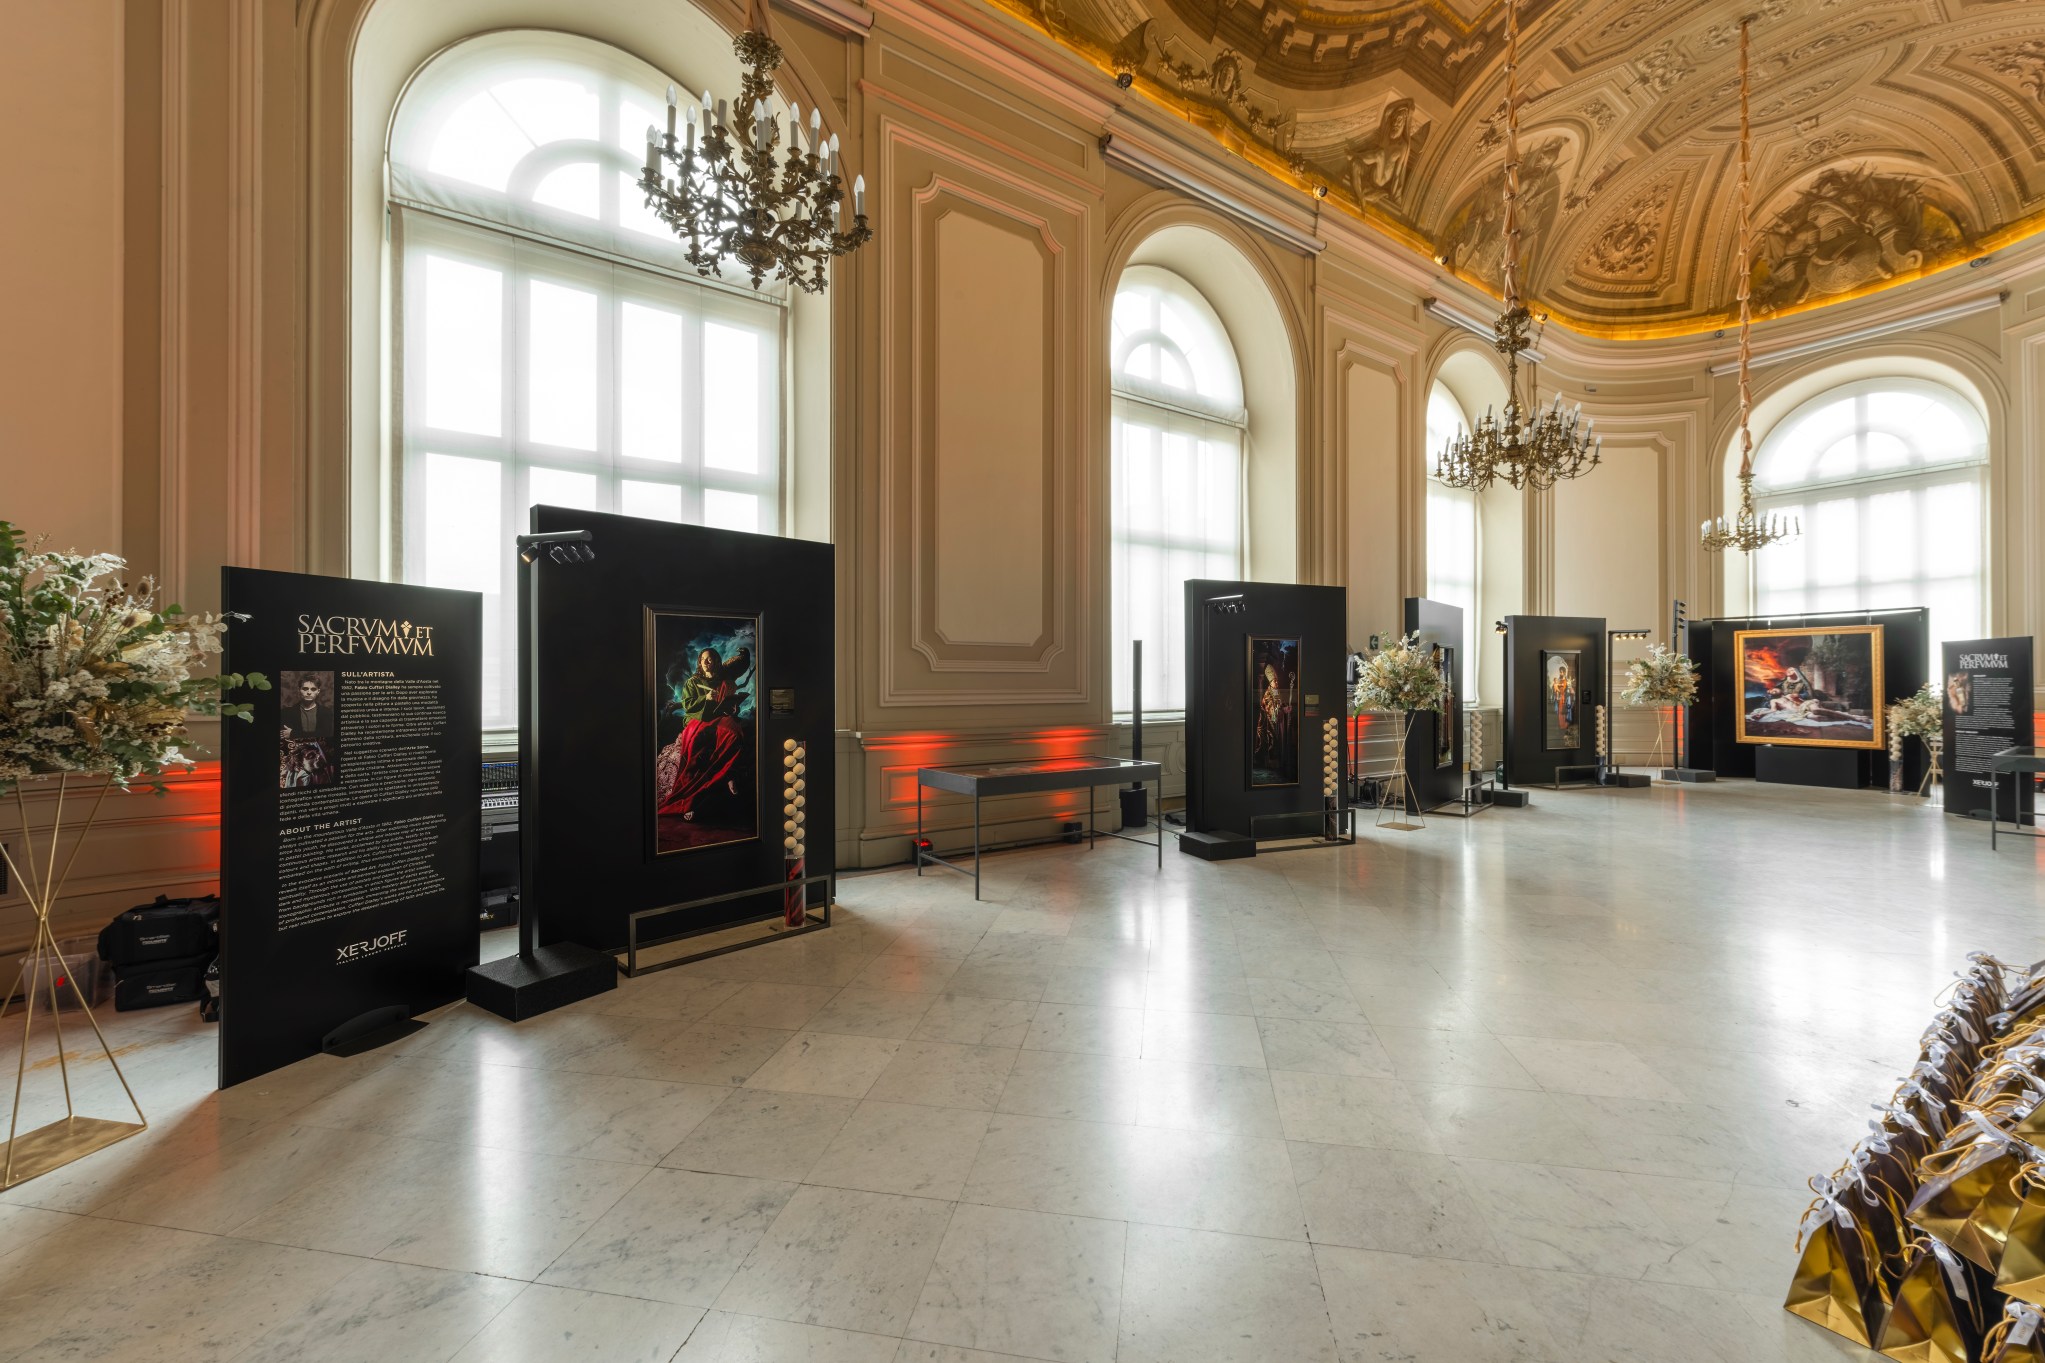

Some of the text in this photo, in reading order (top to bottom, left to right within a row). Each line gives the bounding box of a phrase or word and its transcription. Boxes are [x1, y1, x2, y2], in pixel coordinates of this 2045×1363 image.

[297, 614, 433, 639] SACRVM ET
[298, 633, 434, 656] PERFVMVM
[1972, 779, 2000, 787] XERJOF
[279, 817, 363, 836] ABOUT THE ARTIST
[336, 929, 408, 960] XERJOFF
